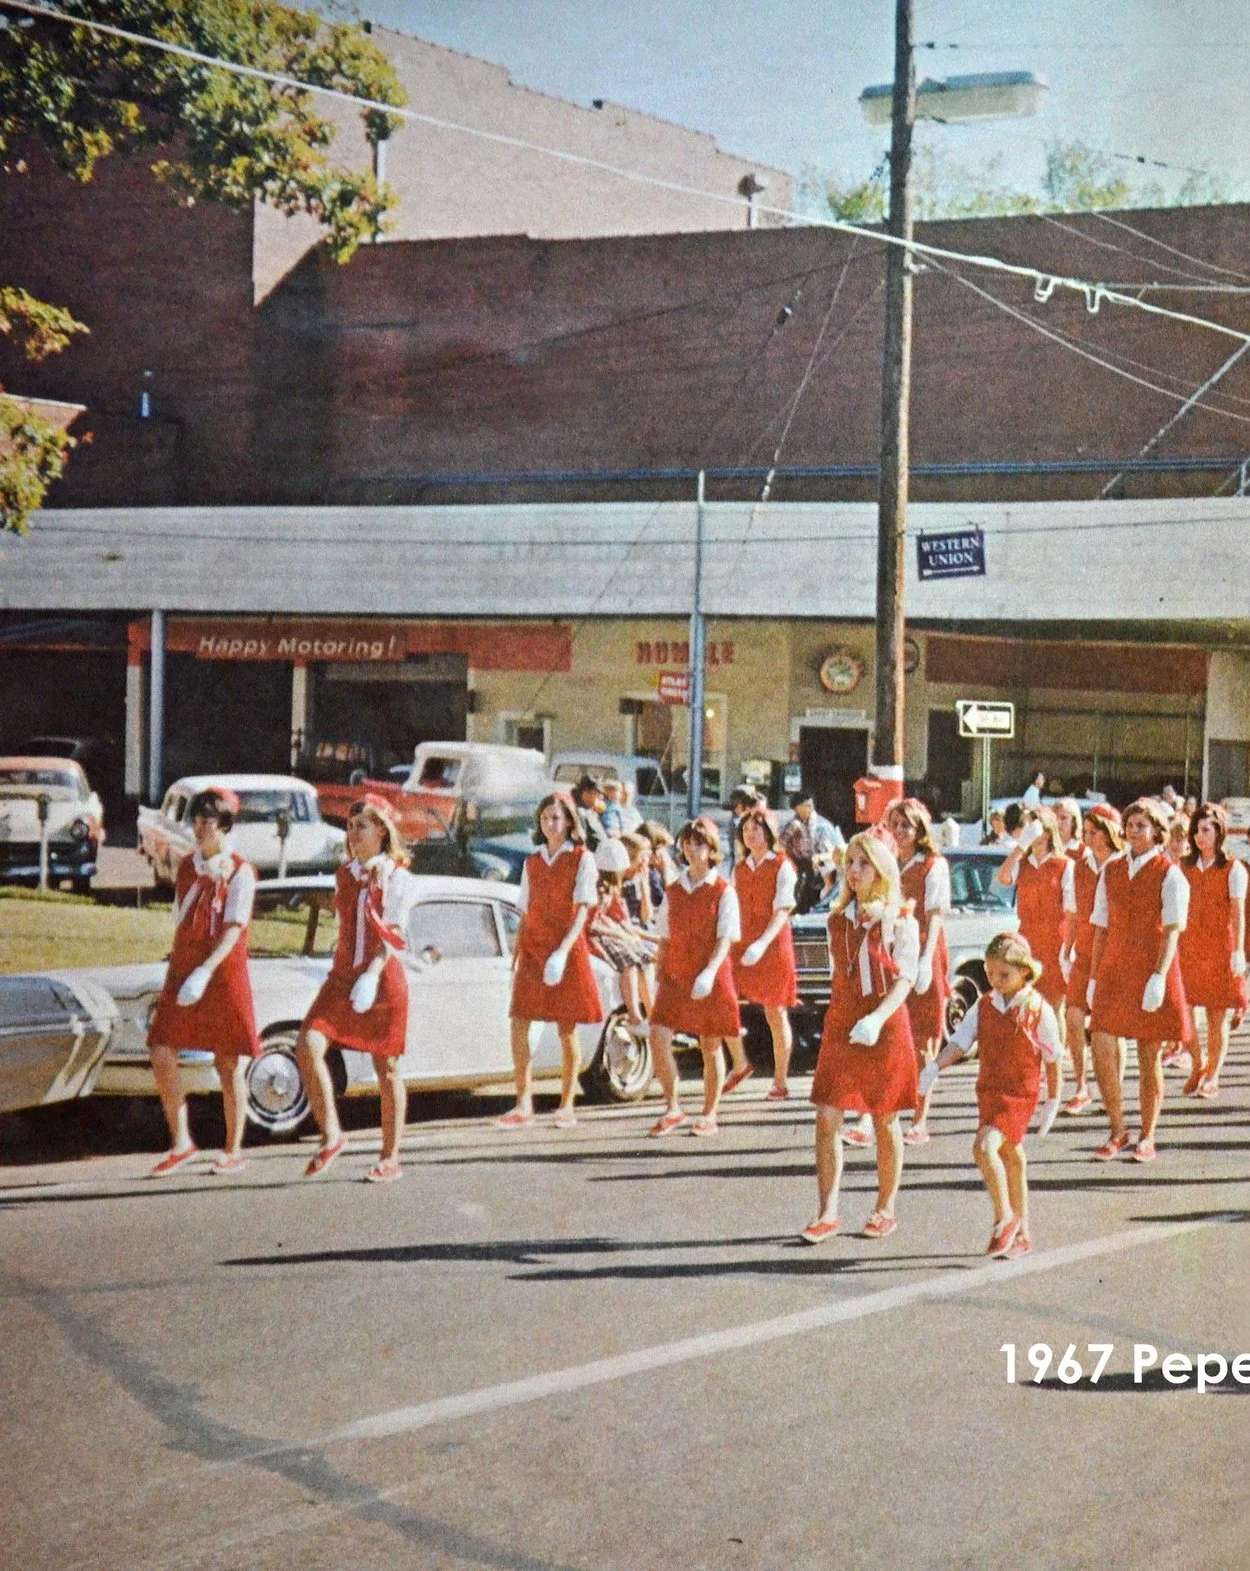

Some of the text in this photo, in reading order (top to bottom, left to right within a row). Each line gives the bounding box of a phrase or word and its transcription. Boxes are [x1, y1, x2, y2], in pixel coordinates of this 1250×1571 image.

[921, 536, 979, 551] WESTERN
[928, 552, 973, 566] UNION
[200, 634, 396, 658] Happy Motoring!
[636, 641, 734, 664] HUMLE
